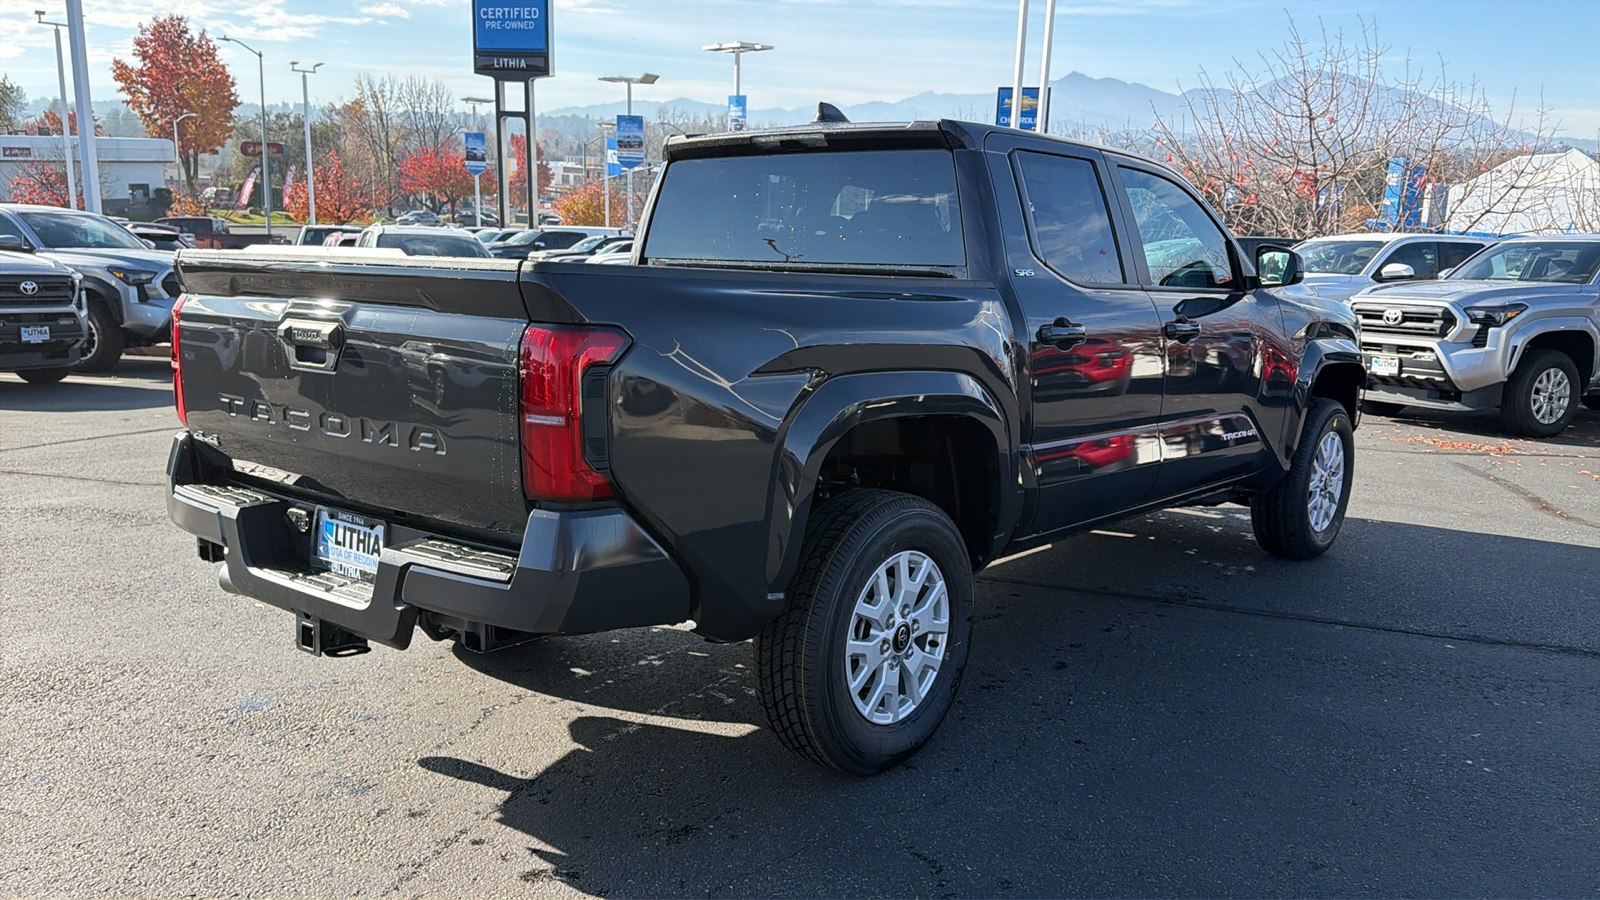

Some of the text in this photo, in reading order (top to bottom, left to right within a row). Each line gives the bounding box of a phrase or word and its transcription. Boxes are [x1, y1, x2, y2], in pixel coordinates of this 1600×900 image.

[480, 7, 539, 19] CERTIFIED
[485, 20, 535, 30] PRE-OWNED
[493, 58, 527, 69] LITHIA
[1014, 268, 1035, 278] SR5
[27, 328, 48, 336] LITHIA
[292, 328, 322, 342] TOYOTA
[1378, 360, 1398, 368] LITHIA
[218, 392, 447, 456] TACOMA
[1221, 429, 1257, 441] TACOMA
[338, 512, 365, 525] SINCE 1946
[334, 523, 381, 558] LITHIA
[321, 543, 378, 568] TOYOTA OF REDDIN
